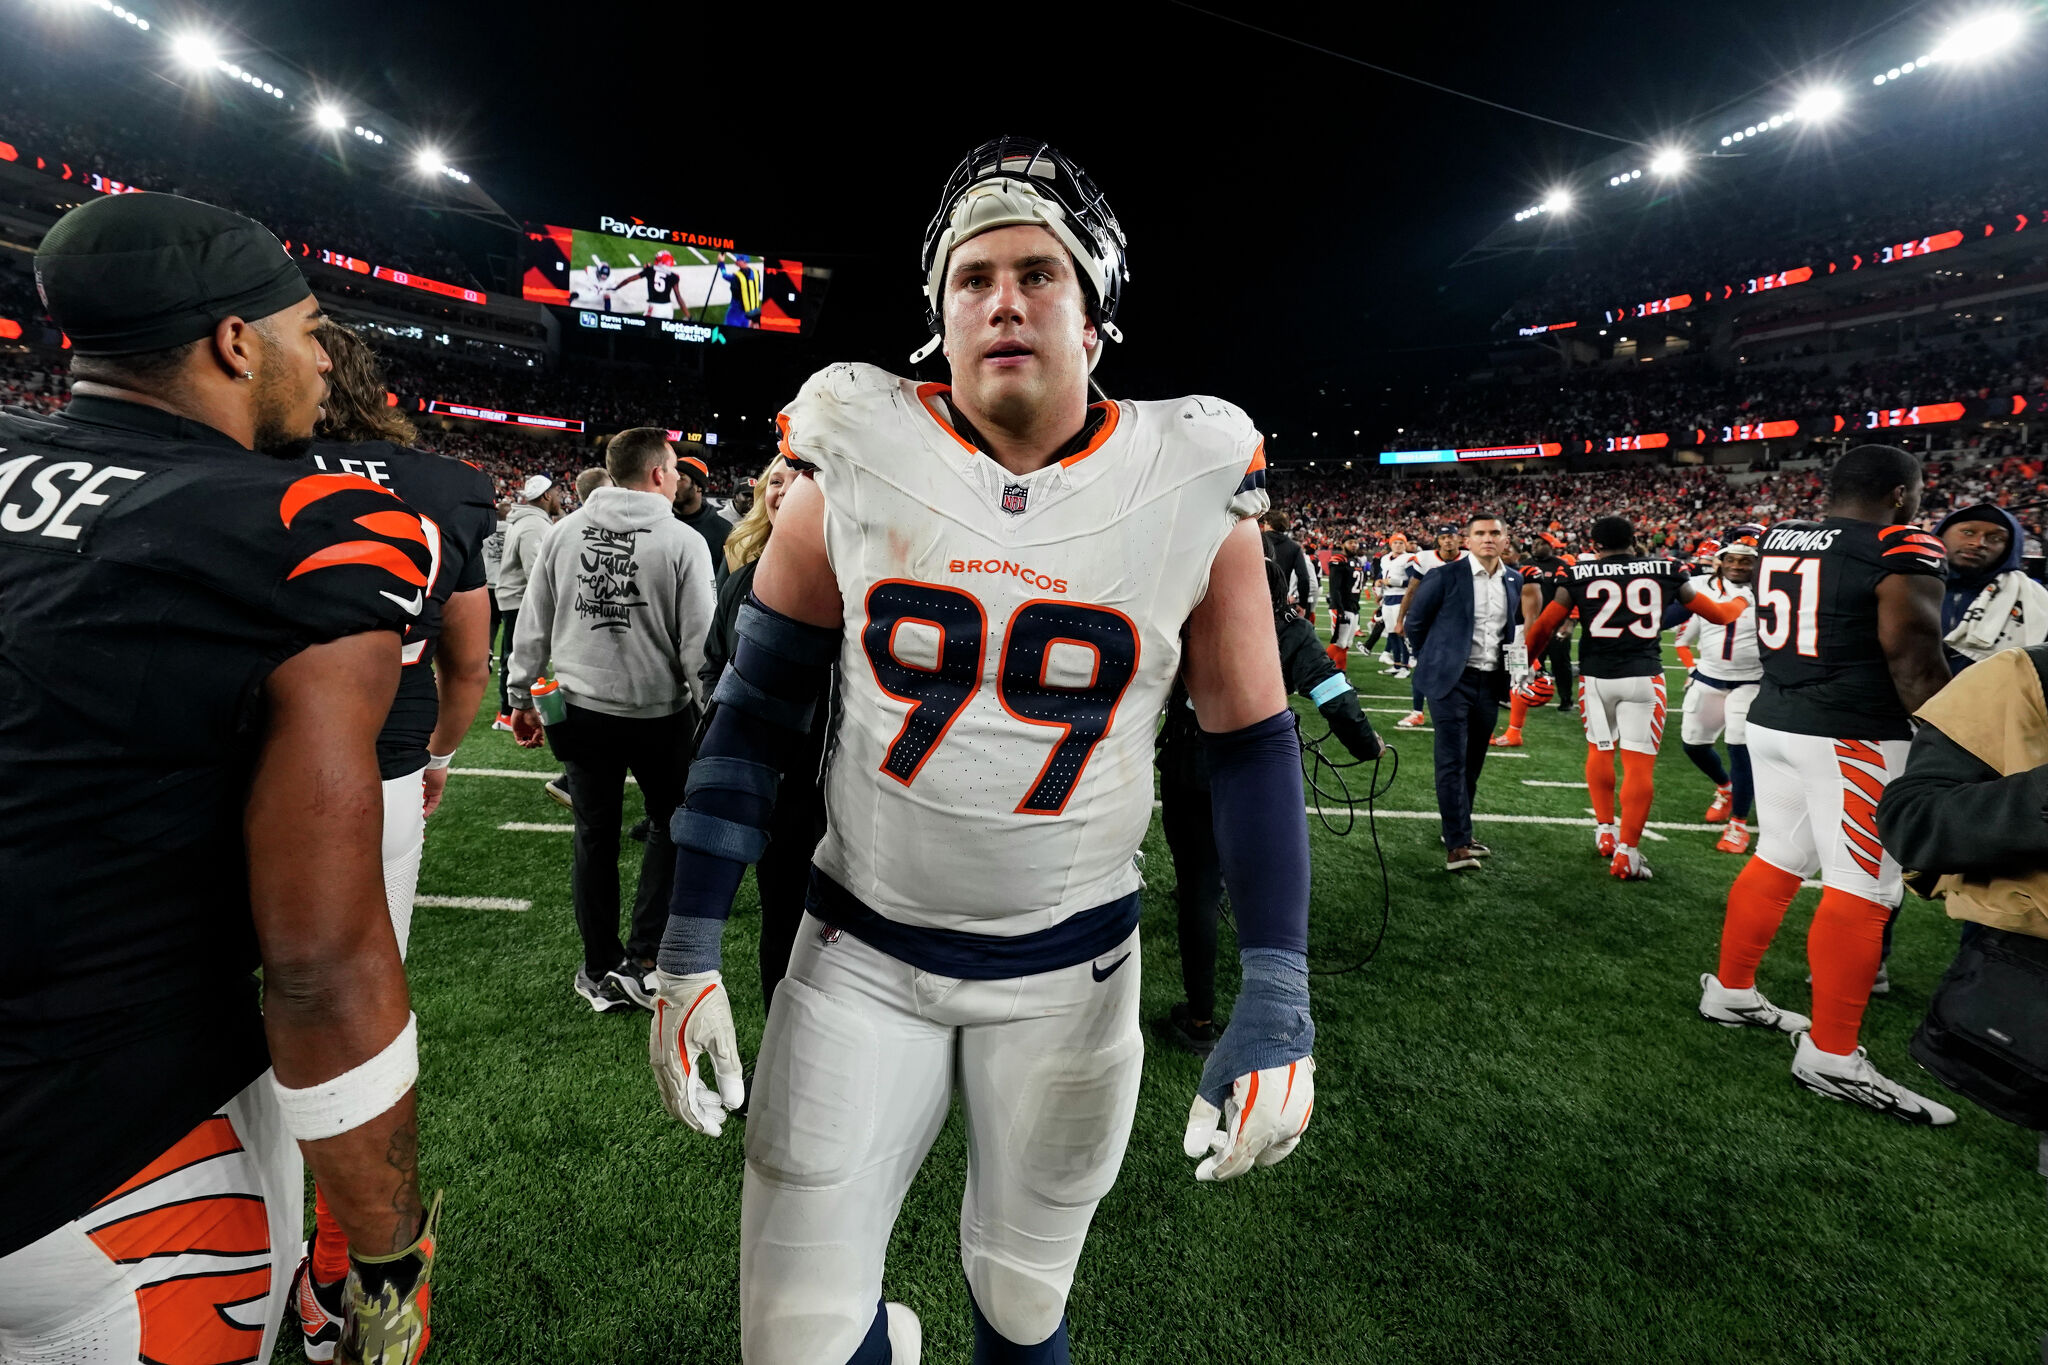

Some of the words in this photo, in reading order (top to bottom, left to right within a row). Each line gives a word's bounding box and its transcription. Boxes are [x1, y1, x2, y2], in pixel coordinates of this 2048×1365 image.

[600, 216, 670, 239] Paycor
[671, 231, 734, 249] STADIUM
[661, 320, 711, 338] Kettering
[1004, 495, 1025, 511] NFL
[1763, 528, 1842, 551] THOMAS
[950, 559, 1068, 594] BRONCOS
[1570, 561, 1672, 581] TAYLOR-BRITT
[1586, 577, 1662, 638] 29
[1758, 556, 1821, 657] 51
[861, 578, 1141, 816] 99
